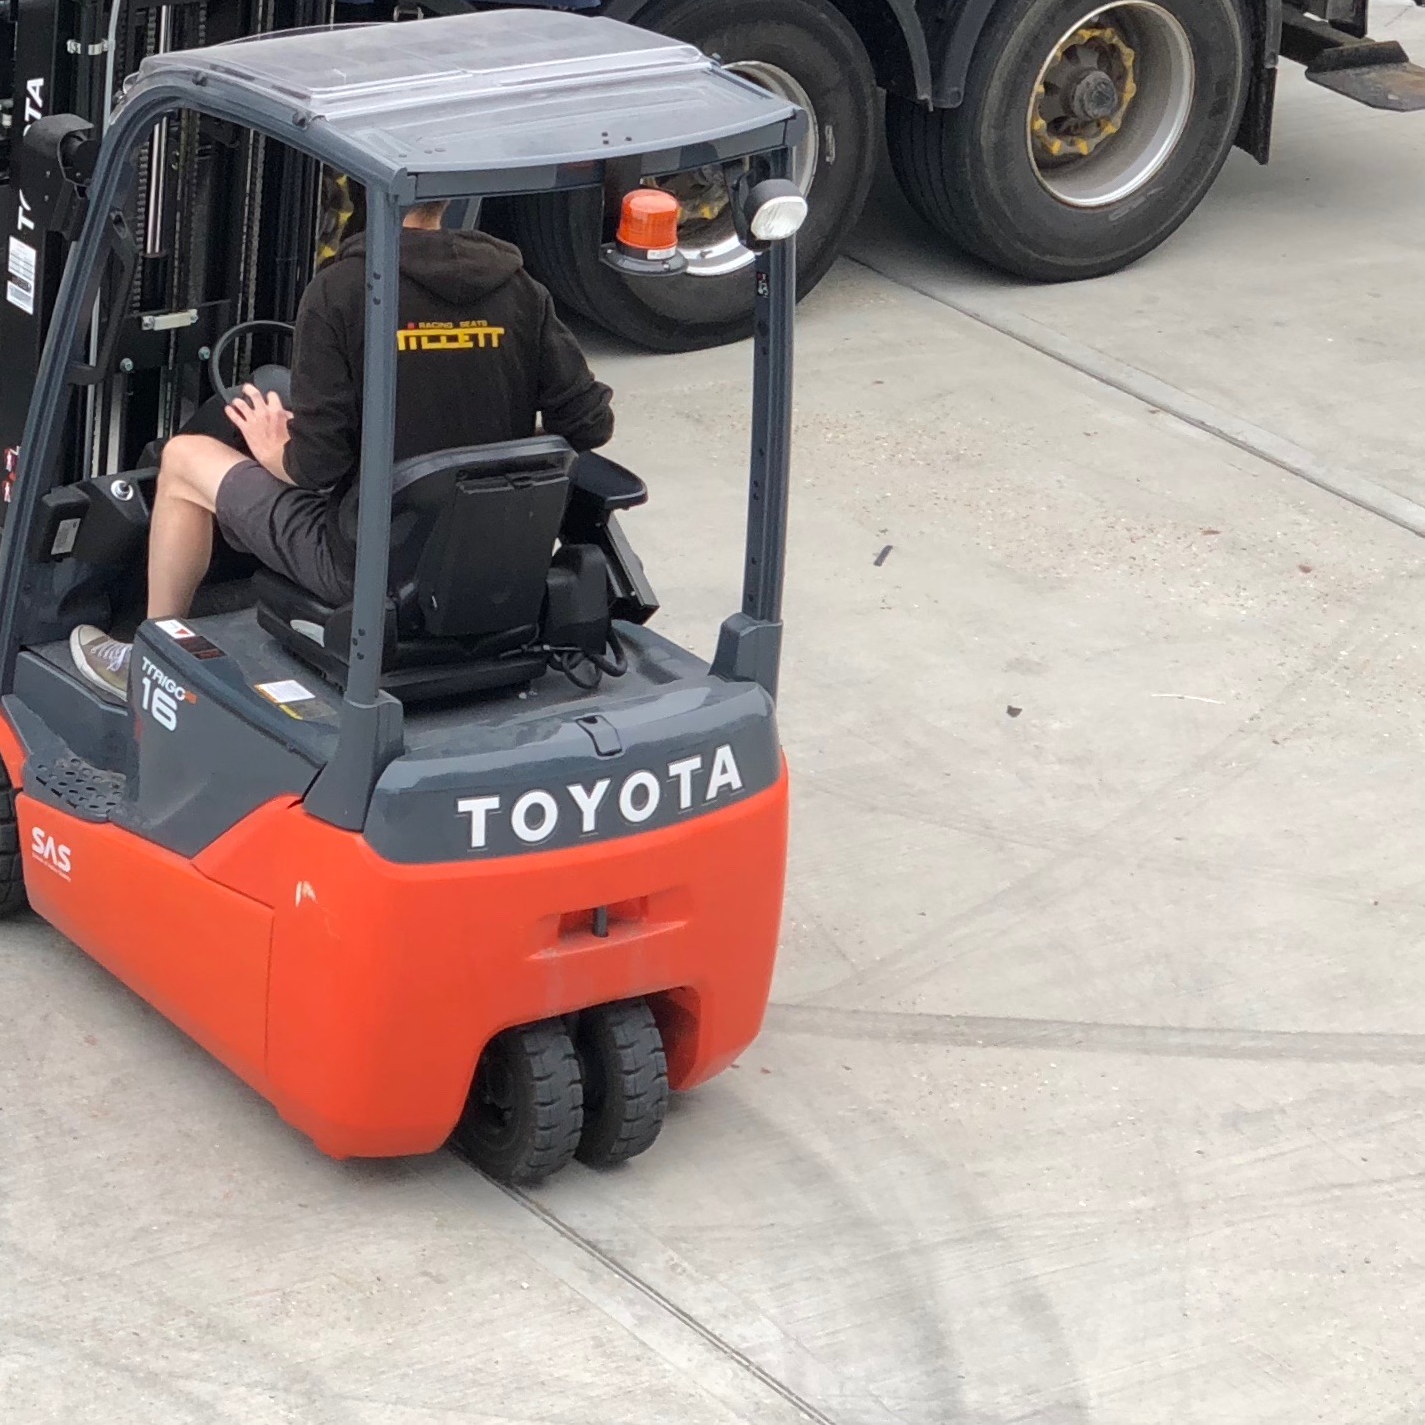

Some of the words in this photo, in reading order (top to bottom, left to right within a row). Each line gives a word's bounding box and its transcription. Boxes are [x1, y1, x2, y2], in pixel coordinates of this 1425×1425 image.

[418, 321, 454, 329] RACING
[141, 676, 178, 732] 16
[457, 743, 743, 848] TOYOTA
[31, 826, 71, 873] SAS
